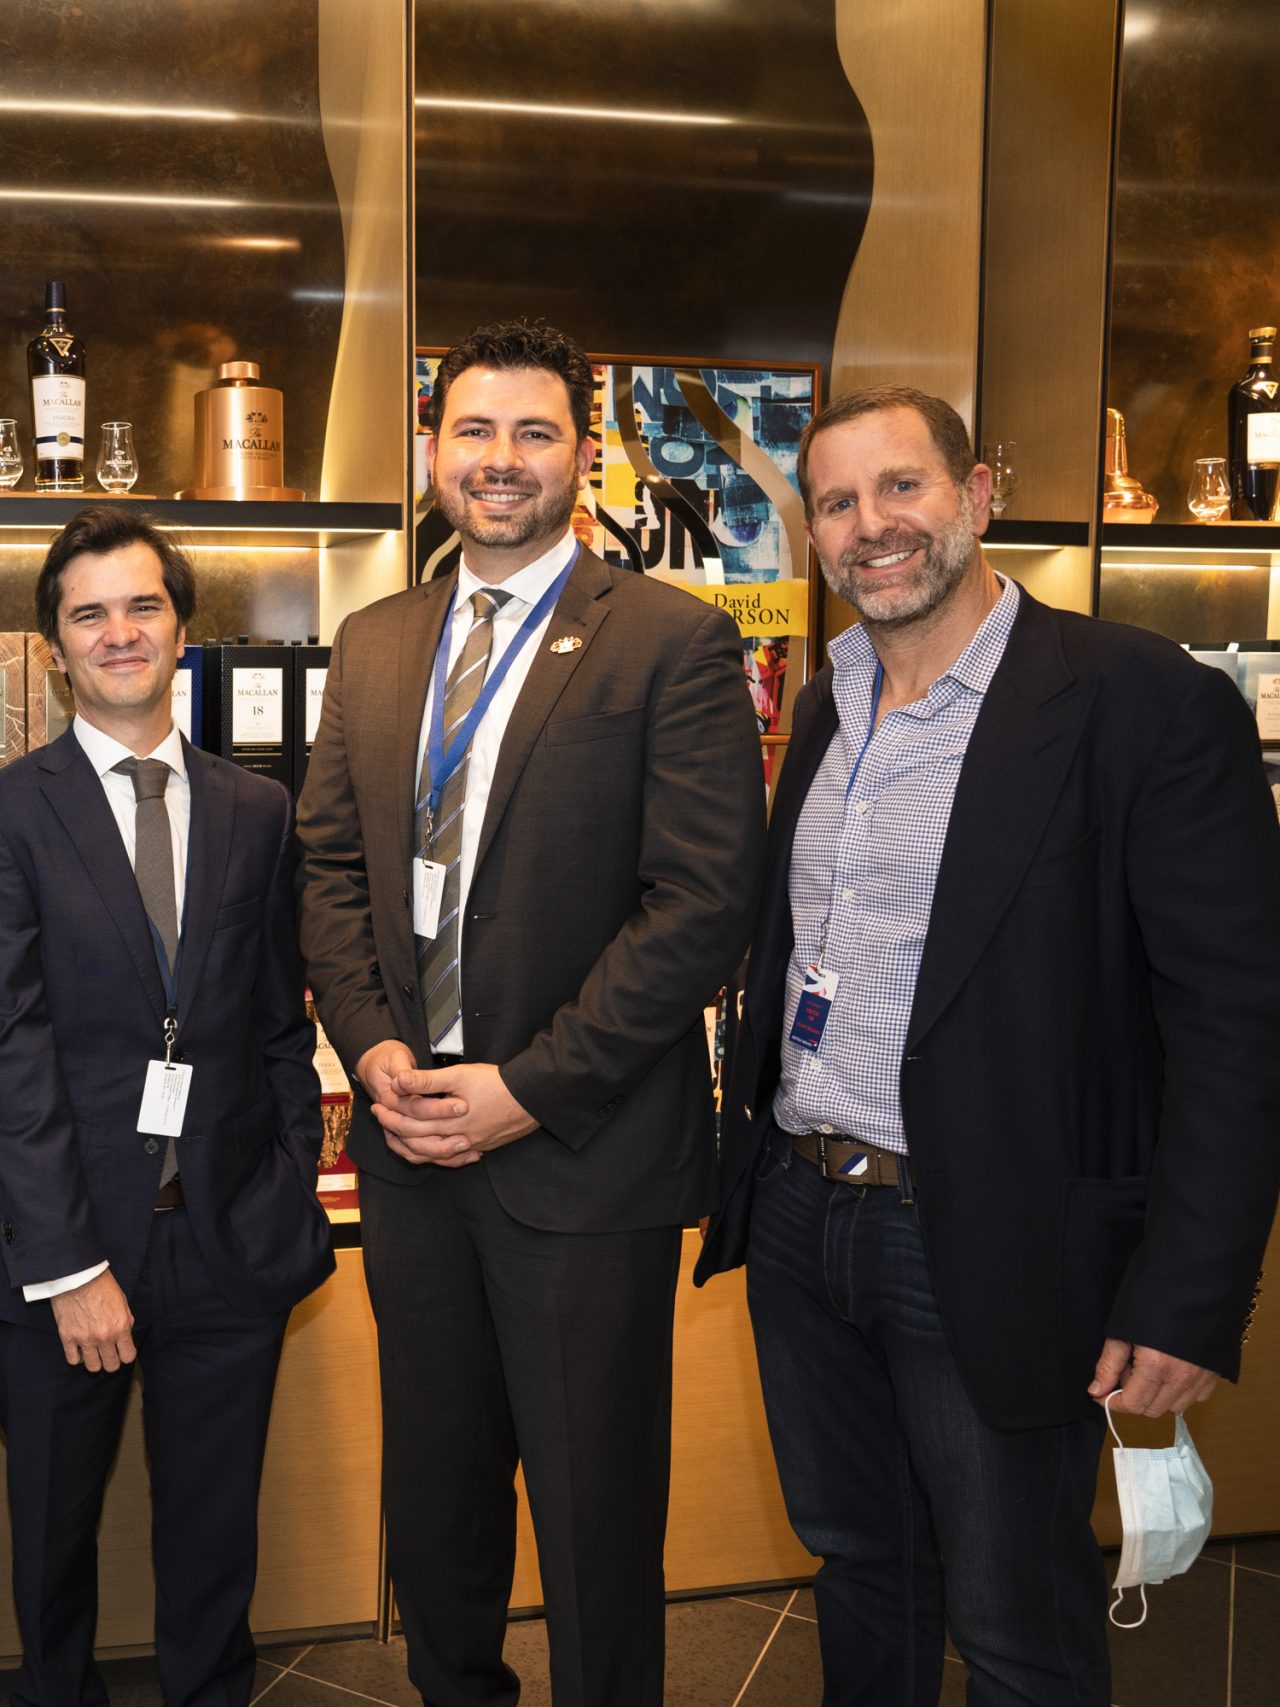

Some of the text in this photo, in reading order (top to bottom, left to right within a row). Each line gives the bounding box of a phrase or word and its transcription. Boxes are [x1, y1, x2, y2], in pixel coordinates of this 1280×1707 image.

[222, 439, 281, 452] MACALLAN
[714, 593, 761, 608] David
[733, 609, 790, 624] RSON
[252, 706, 264, 716] 18
